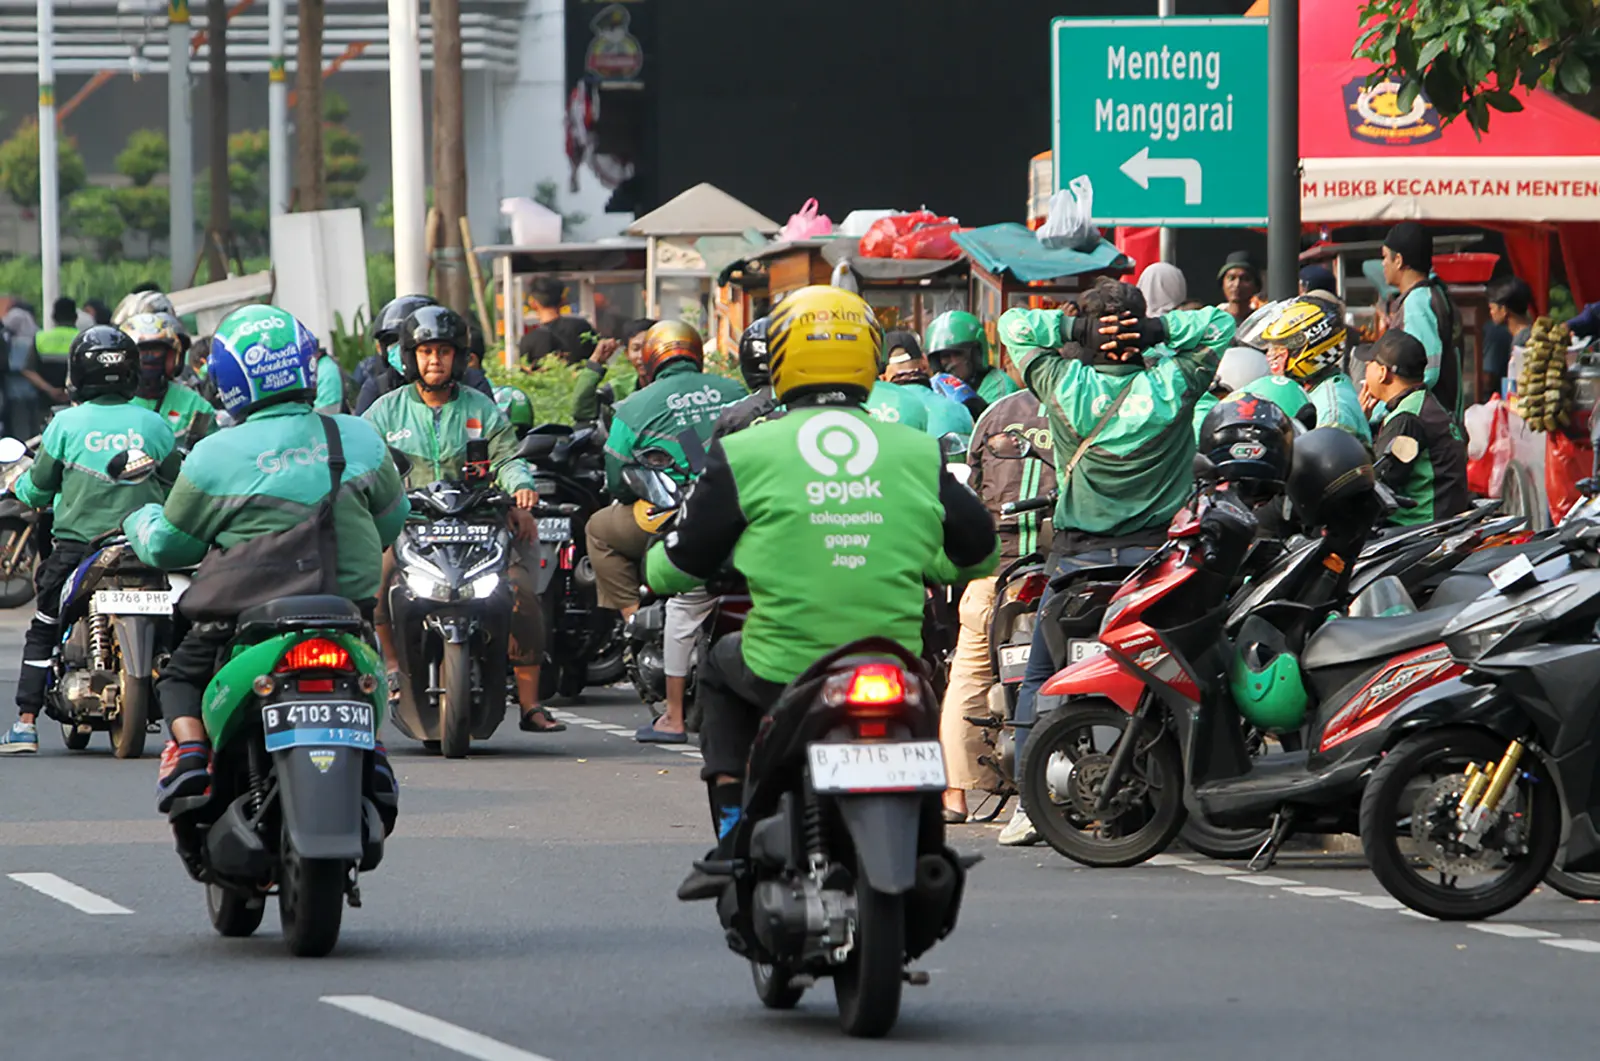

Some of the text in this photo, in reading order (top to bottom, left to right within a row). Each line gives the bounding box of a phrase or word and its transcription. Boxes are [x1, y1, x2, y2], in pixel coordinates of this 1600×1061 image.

[1107, 45, 1220, 90] Menteng
[1095, 93, 1233, 141] Manggarai
[1323, 180, 1377, 197] HBKB
[1383, 179, 1510, 196] KECAMATAN
[1516, 180, 1600, 197] MENTEN
[239, 315, 285, 336] Grab
[800, 307, 863, 325] maxim
[1303, 318, 1329, 341] KYT
[667, 385, 721, 410] Grab
[84, 428, 145, 452] Grab
[385, 428, 413, 442] Grab
[1235, 447, 1263, 458] agv
[805, 476, 883, 505] gojek
[809, 511, 884, 528] tokopedia
[824, 533, 871, 549] gopay
[832, 553, 867, 569] Jago
[99, 592, 170, 604] B 3768 PHP
[1005, 651, 1014, 665] B
[267, 705, 370, 728] B 4103 SXW
[815, 745, 940, 765] B 3716 PNX
